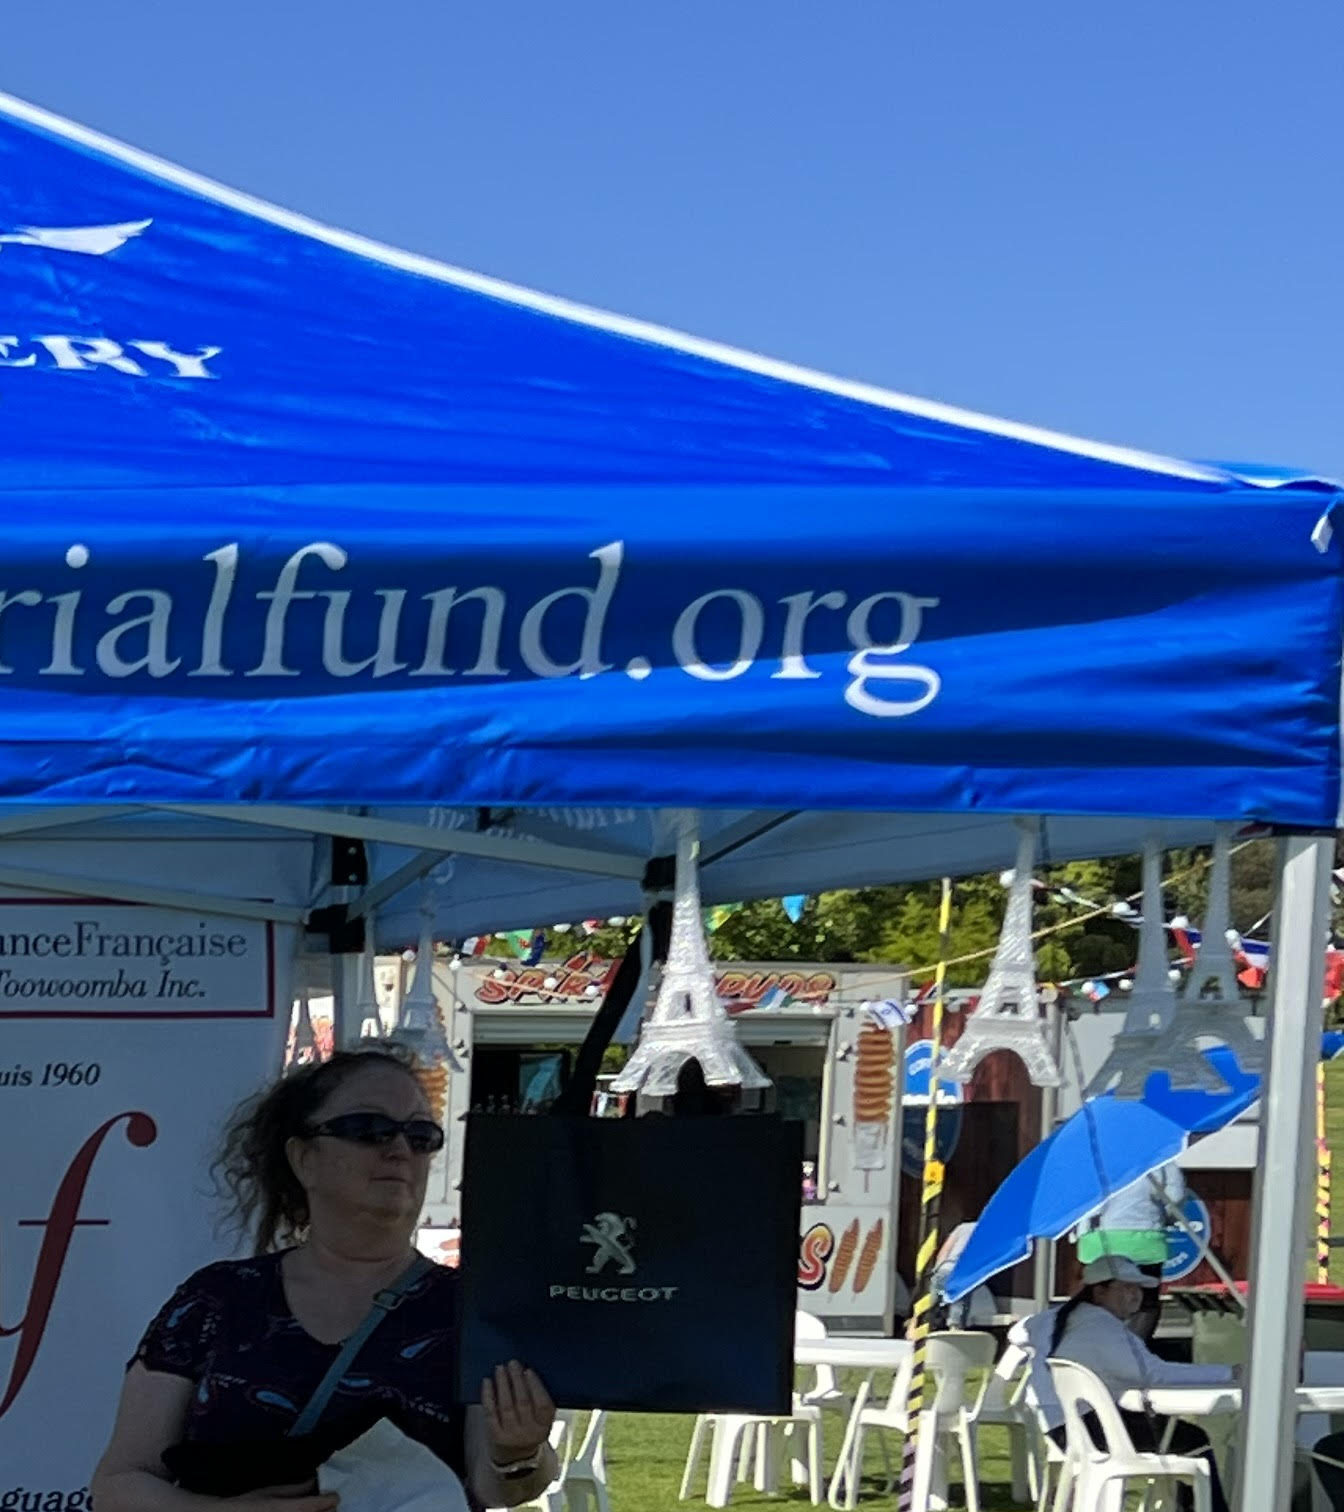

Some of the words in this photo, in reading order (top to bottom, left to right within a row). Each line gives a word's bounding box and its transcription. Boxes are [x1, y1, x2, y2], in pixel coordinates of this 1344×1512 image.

[158, 969, 207, 998] Inc.
[41, 1063, 102, 1087] 1960
[549, 1284, 680, 1303] PEUGEOT
